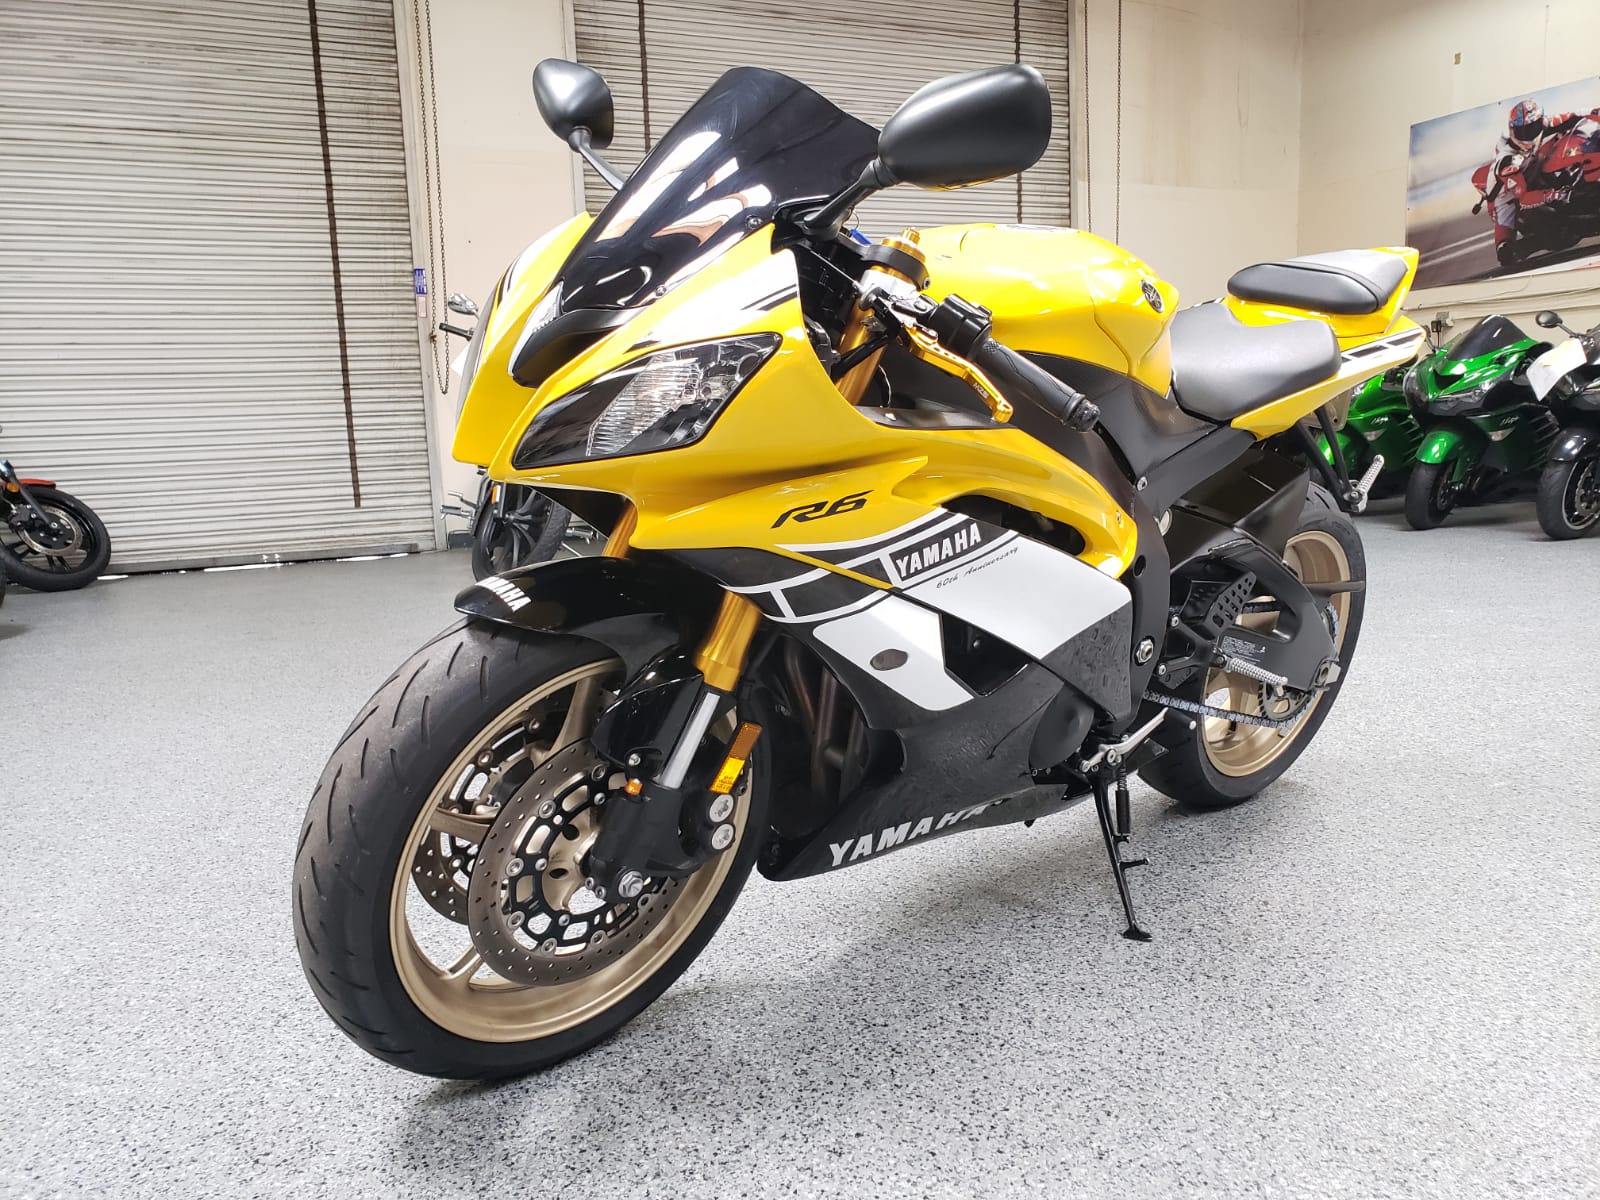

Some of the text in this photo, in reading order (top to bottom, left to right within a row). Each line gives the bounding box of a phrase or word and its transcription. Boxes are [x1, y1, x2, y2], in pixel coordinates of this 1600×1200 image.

[770, 490, 874, 529] R6
[896, 522, 981, 578] YAMAHA
[475, 576, 532, 612] AMAHA
[829, 803, 989, 867] YAMAHA
